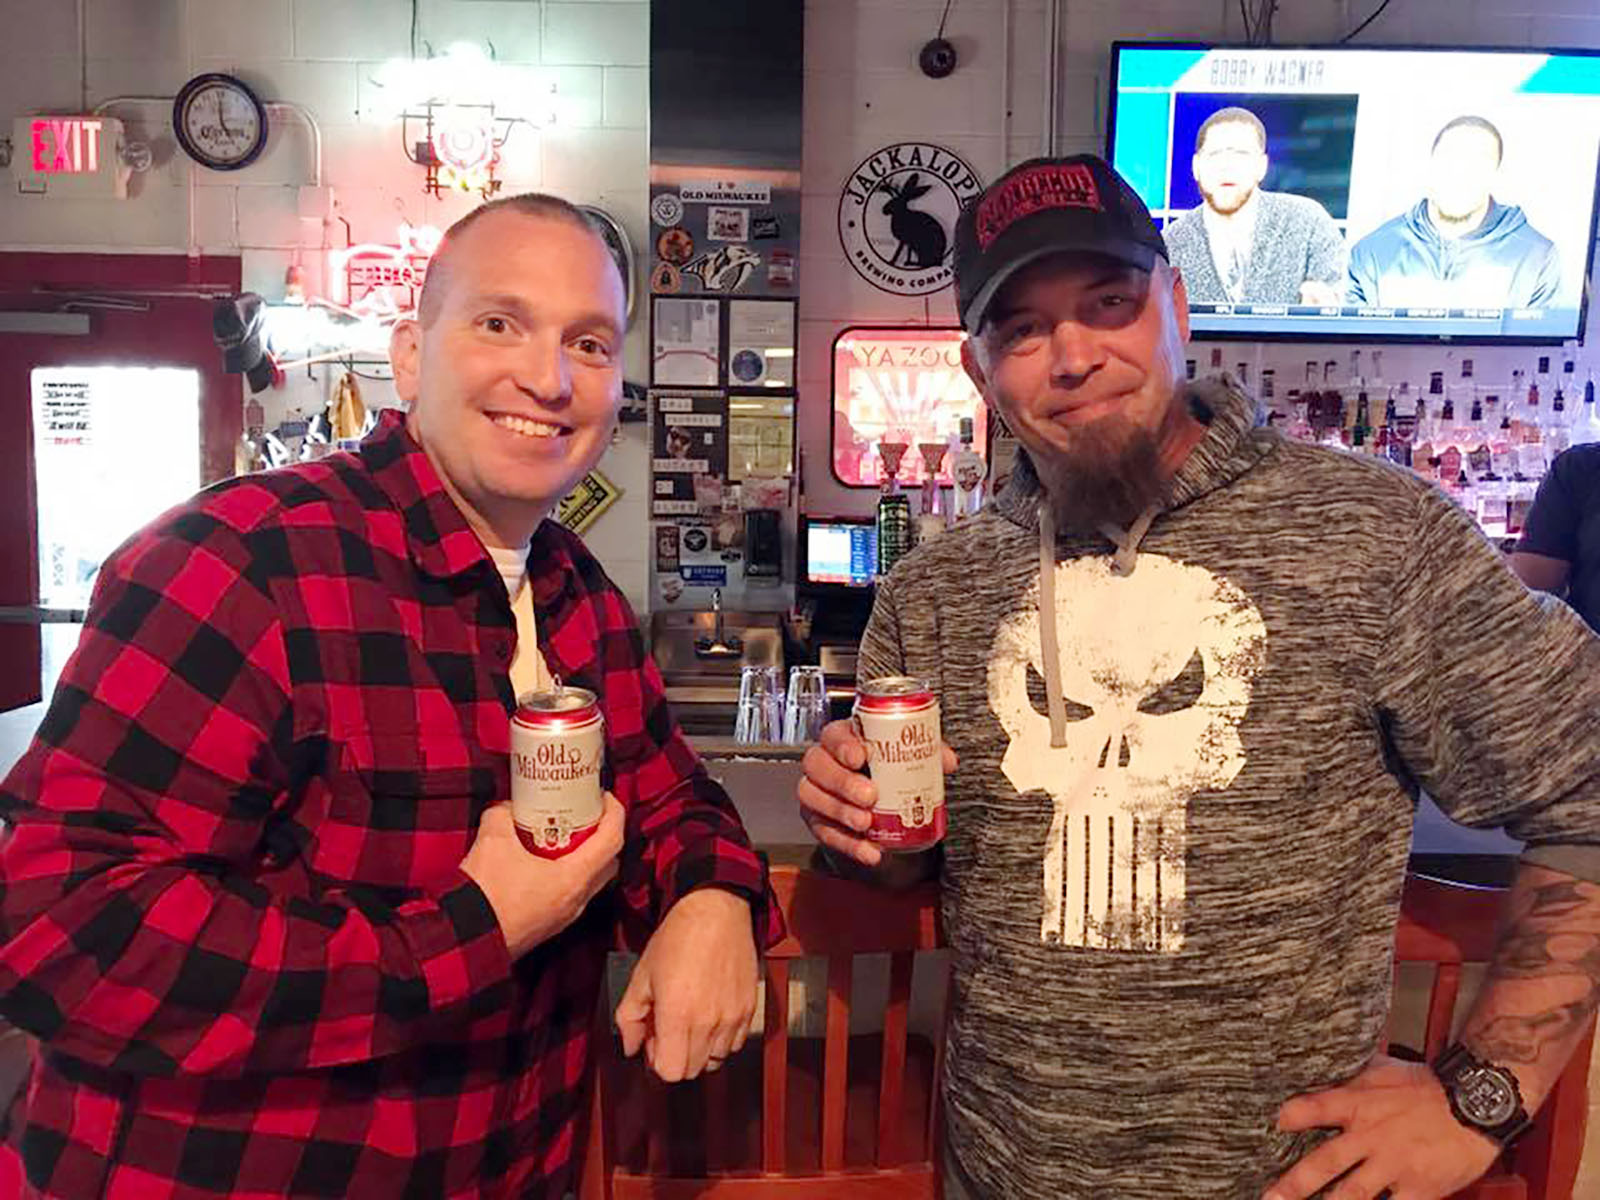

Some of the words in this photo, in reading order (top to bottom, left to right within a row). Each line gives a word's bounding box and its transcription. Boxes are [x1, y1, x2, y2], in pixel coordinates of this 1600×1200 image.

[32, 119, 102, 173] EXIT
[682, 190, 703, 200] OLD
[705, 191, 768, 201] MILWAUKEE
[900, 723, 926, 747] Old
[537, 743, 566, 766] Old
